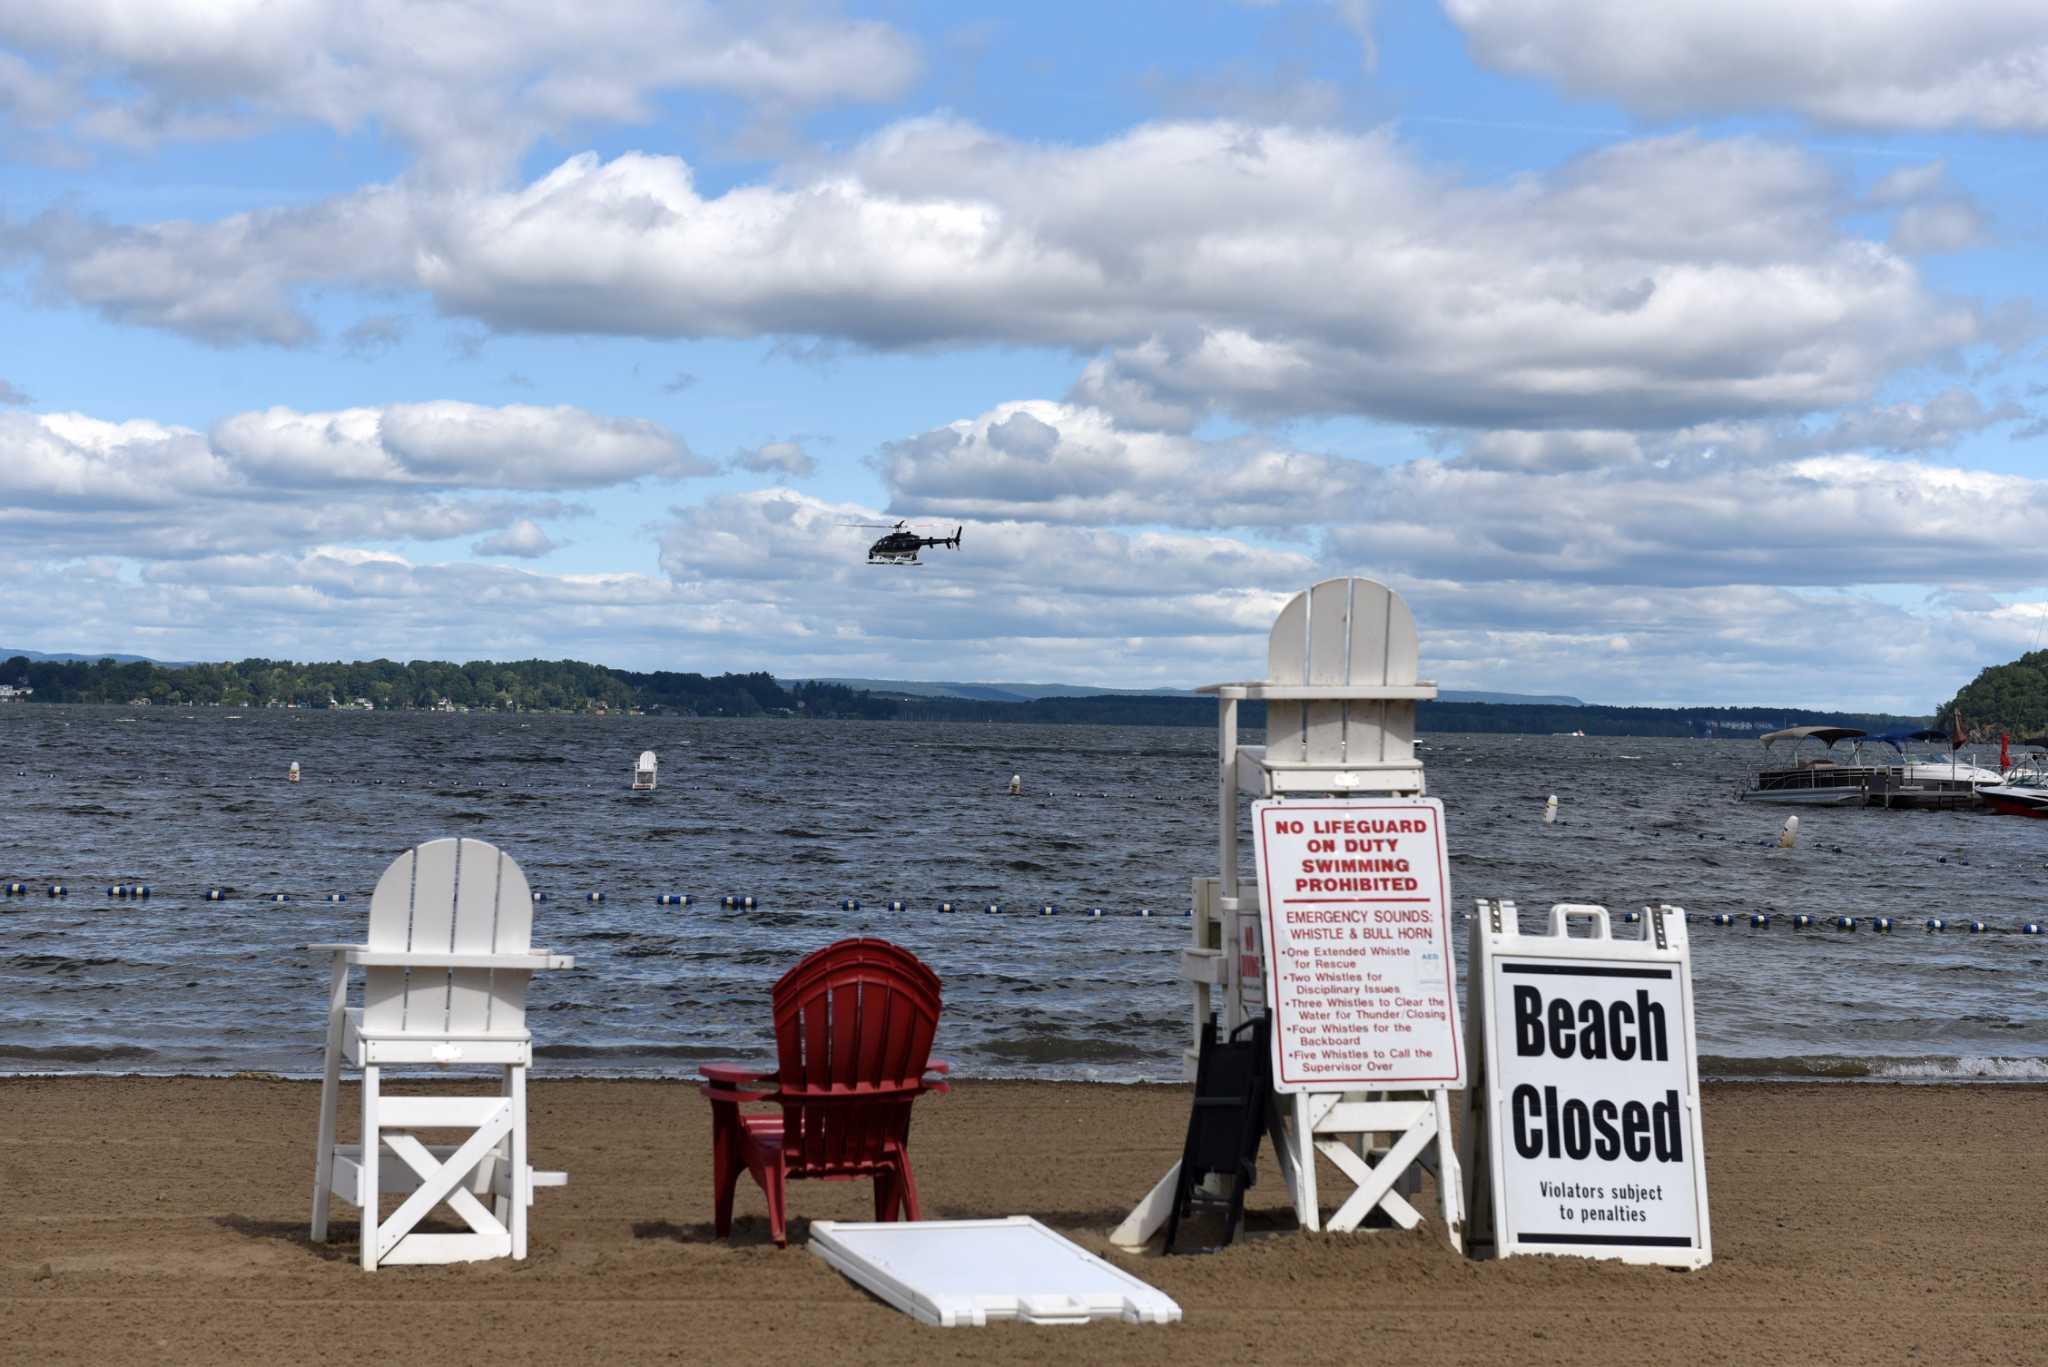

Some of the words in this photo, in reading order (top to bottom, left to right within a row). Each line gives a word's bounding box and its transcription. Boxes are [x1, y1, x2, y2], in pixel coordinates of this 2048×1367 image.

[1275, 820, 1304, 834] NO
[1314, 819, 1427, 834] LIFEGUARD
[1307, 839, 1335, 853] ON
[1345, 838, 1398, 852] DUTY
[1302, 858, 1410, 873] SWIMMING
[1296, 877, 1418, 892] PROHIBITED
[1286, 910, 1368, 924] EMERGENCY
[1374, 910, 1433, 922] SOUNDS:
[1290, 928, 1343, 940] WHISTLE
[1350, 928, 1358, 939] &
[1363, 928, 1393, 939] BULL
[1399, 927, 1432, 939] HORN
[1287, 947, 1309, 957] One
[1314, 946, 1366, 957] Extended
[1371, 946, 1411, 956] Whistle
[1295, 960, 1311, 969] for
[1315, 959, 1357, 969] Rescue
[1289, 973, 1311, 983] Two
[1315, 972, 1362, 982] Whistles
[1367, 972, 1383, 981] for
[1296, 985, 1360, 996] Disciplinary
[1364, 984, 1400, 994] Issues
[1291, 999, 1323, 1009] Three
[1327, 998, 1374, 1008] Whistles
[1379, 998, 1390, 1007] to
[1395, 997, 1423, 1007] Clear
[1428, 998, 1445, 1007] the
[1299, 1011, 1330, 1021] Water
[1336, 1011, 1350, 1020] for
[1292, 1025, 1317, 1034] Four
[1321, 1024, 1369, 1034] Whistles
[1373, 1024, 1389, 1033] for
[1394, 1023, 1412, 1033] the
[1512, 984, 1670, 1062] Beach
[1300, 1036, 1361, 1047] Backboard
[1294, 1050, 1317, 1060] Five
[1321, 1050, 1369, 1060] Whistles
[1373, 1050, 1385, 1059] to
[1389, 1049, 1410, 1059] Call
[1415, 1049, 1433, 1058] the
[1303, 1062, 1362, 1073] Supervisor
[1367, 1061, 1393, 1072] Over
[1511, 1083, 1684, 1163] Closed
[1540, 1181, 1605, 1200] Violators
[1611, 1183, 1663, 1203] subject
[1560, 1204, 1574, 1221] to
[1581, 1205, 1647, 1224] penalties
